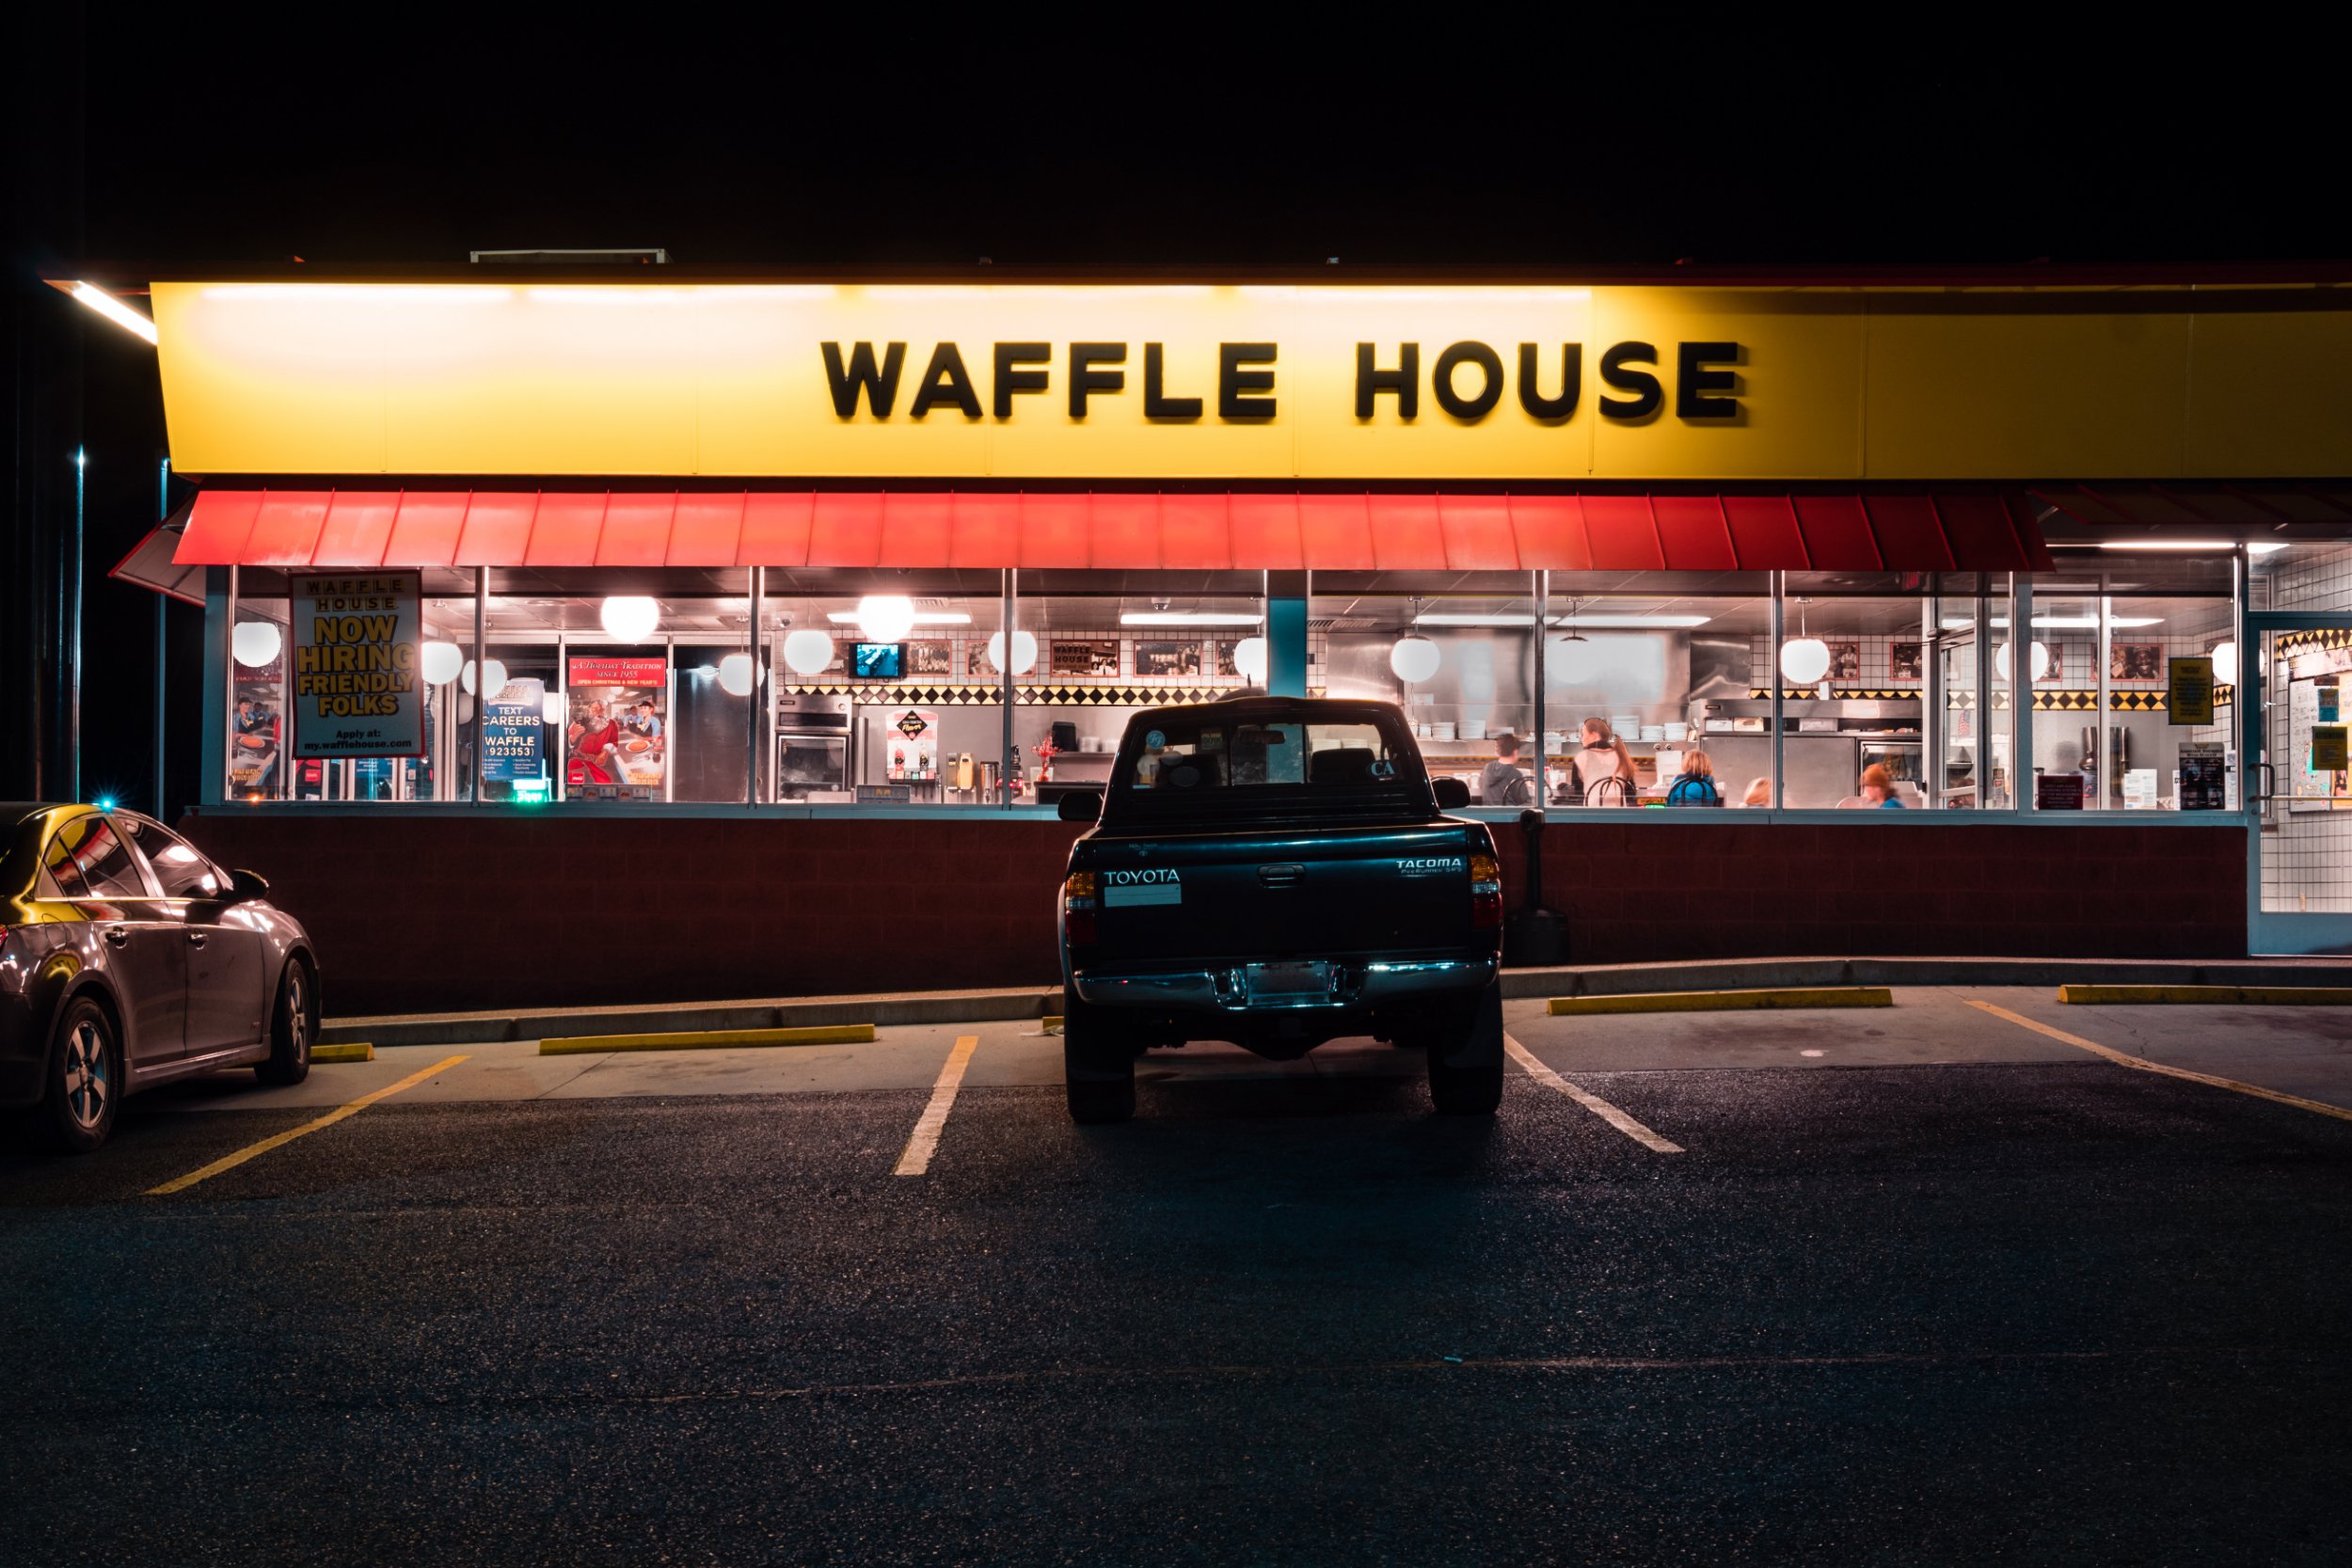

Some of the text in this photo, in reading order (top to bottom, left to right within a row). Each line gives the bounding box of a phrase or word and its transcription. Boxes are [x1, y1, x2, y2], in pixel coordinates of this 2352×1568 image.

[820, 341, 1740, 420] WAFFLE HOUSE
[308, 578, 404, 594] WAFFLE
[317, 596, 396, 610] HOUSE
[314, 615, 399, 644] NOW
[1054, 645, 1090, 654] WAFFLE
[297, 642, 417, 673] HIRING
[1055, 655, 1089, 663] HOUSE
[621, 660, 662, 670] TRADITION
[298, 672, 415, 696] FRIENDLY
[318, 694, 399, 717] FOLKS
[498, 706, 524, 715] TEXT
[482, 716, 540, 726] CAREERS
[336, 730, 381, 740] Apply at:
[485, 736, 535, 746] WAFFLE
[304, 739, 412, 751] my.wafflehouse.com
[485, 747, 534, 756] (923353)
[1371, 761, 1395, 776] CA
[1396, 858, 1461, 868] TACOMA
[1104, 869, 1180, 885] TOYOTA
